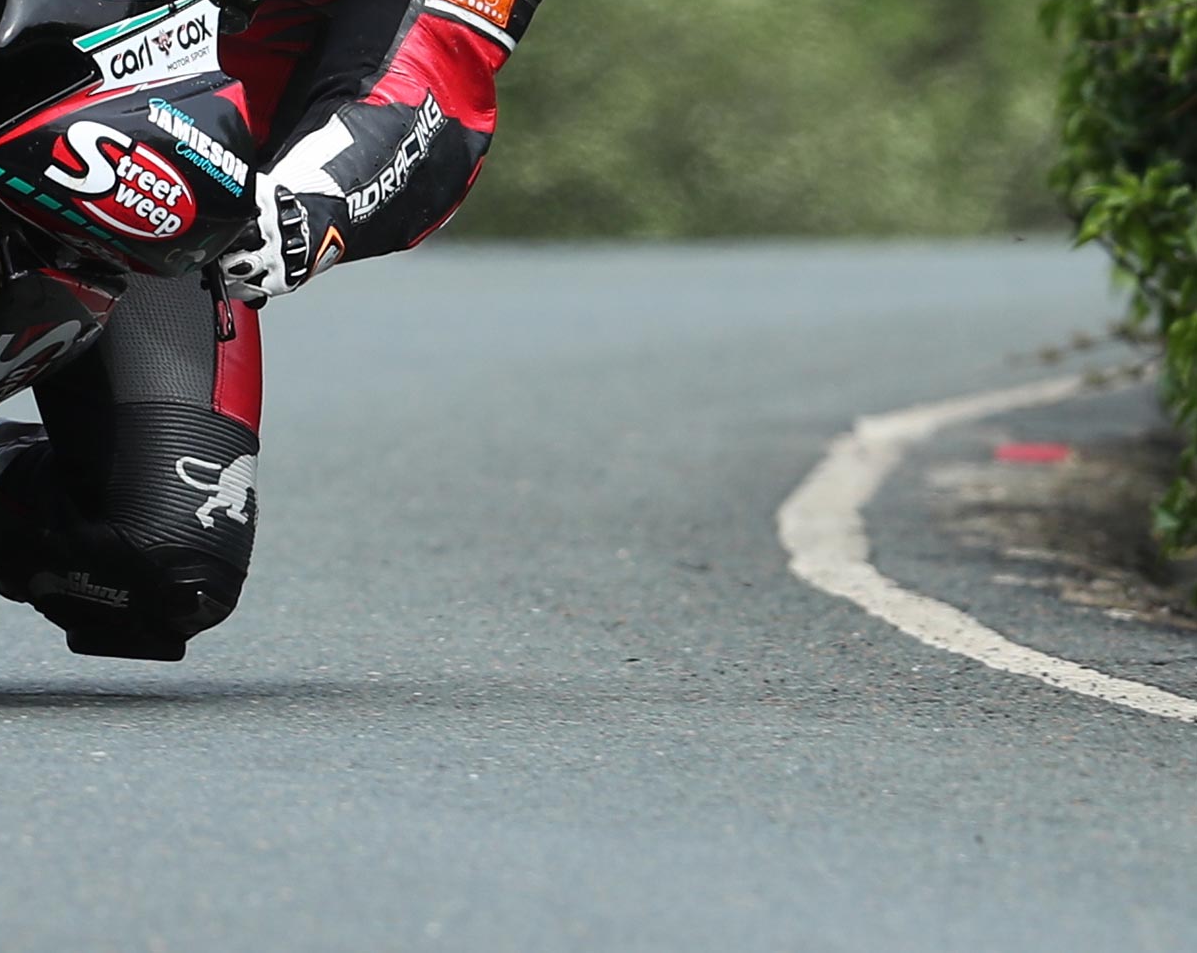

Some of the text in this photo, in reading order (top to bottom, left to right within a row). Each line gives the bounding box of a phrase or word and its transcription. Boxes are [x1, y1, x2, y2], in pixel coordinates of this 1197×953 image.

[110, 13, 213, 80] carl cox
[166, 45, 211, 73] MOTOR SPORT
[147, 103, 250, 187] JAMIESON
[175, 140, 243, 198] Construction
